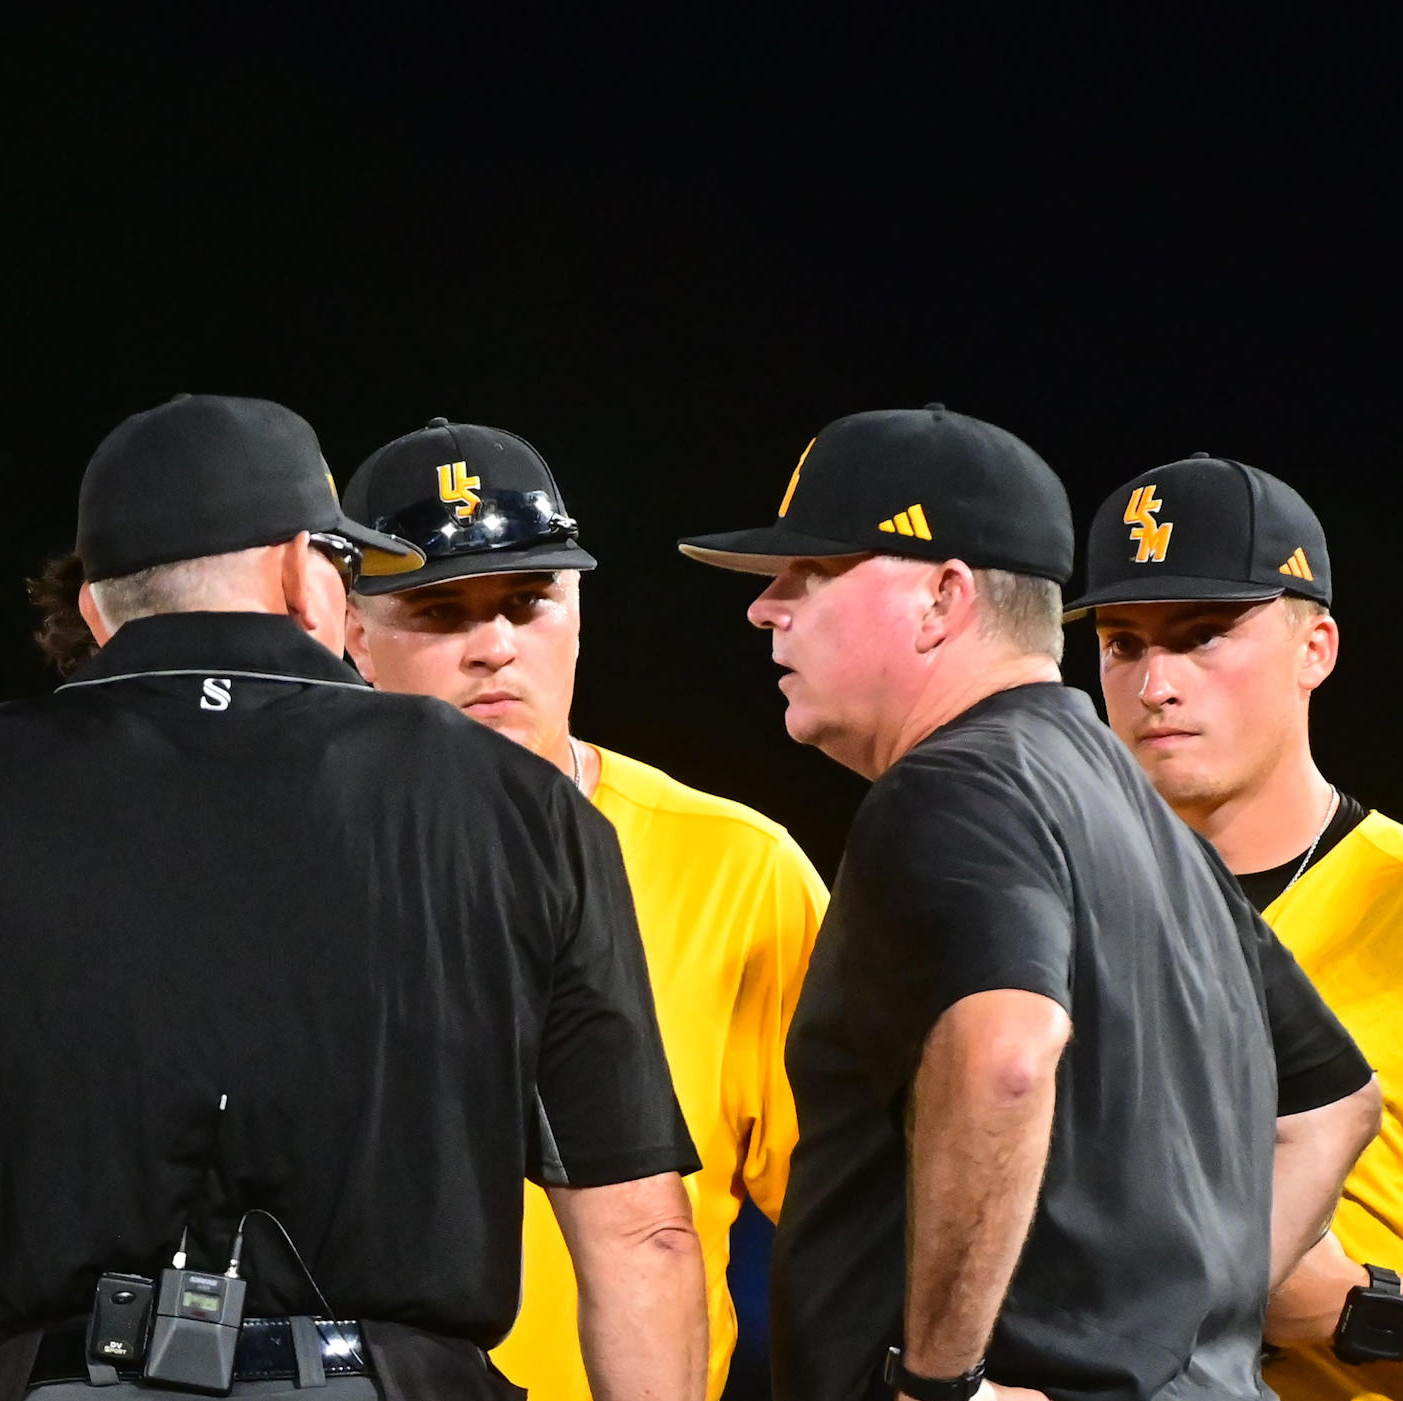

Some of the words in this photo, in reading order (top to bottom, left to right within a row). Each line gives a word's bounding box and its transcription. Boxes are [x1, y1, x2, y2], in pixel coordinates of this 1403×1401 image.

[437, 461, 481, 518] US
[1124, 485, 1173, 563] USM
[200, 678, 231, 711] S
[110, 1341, 123, 1349] DV
